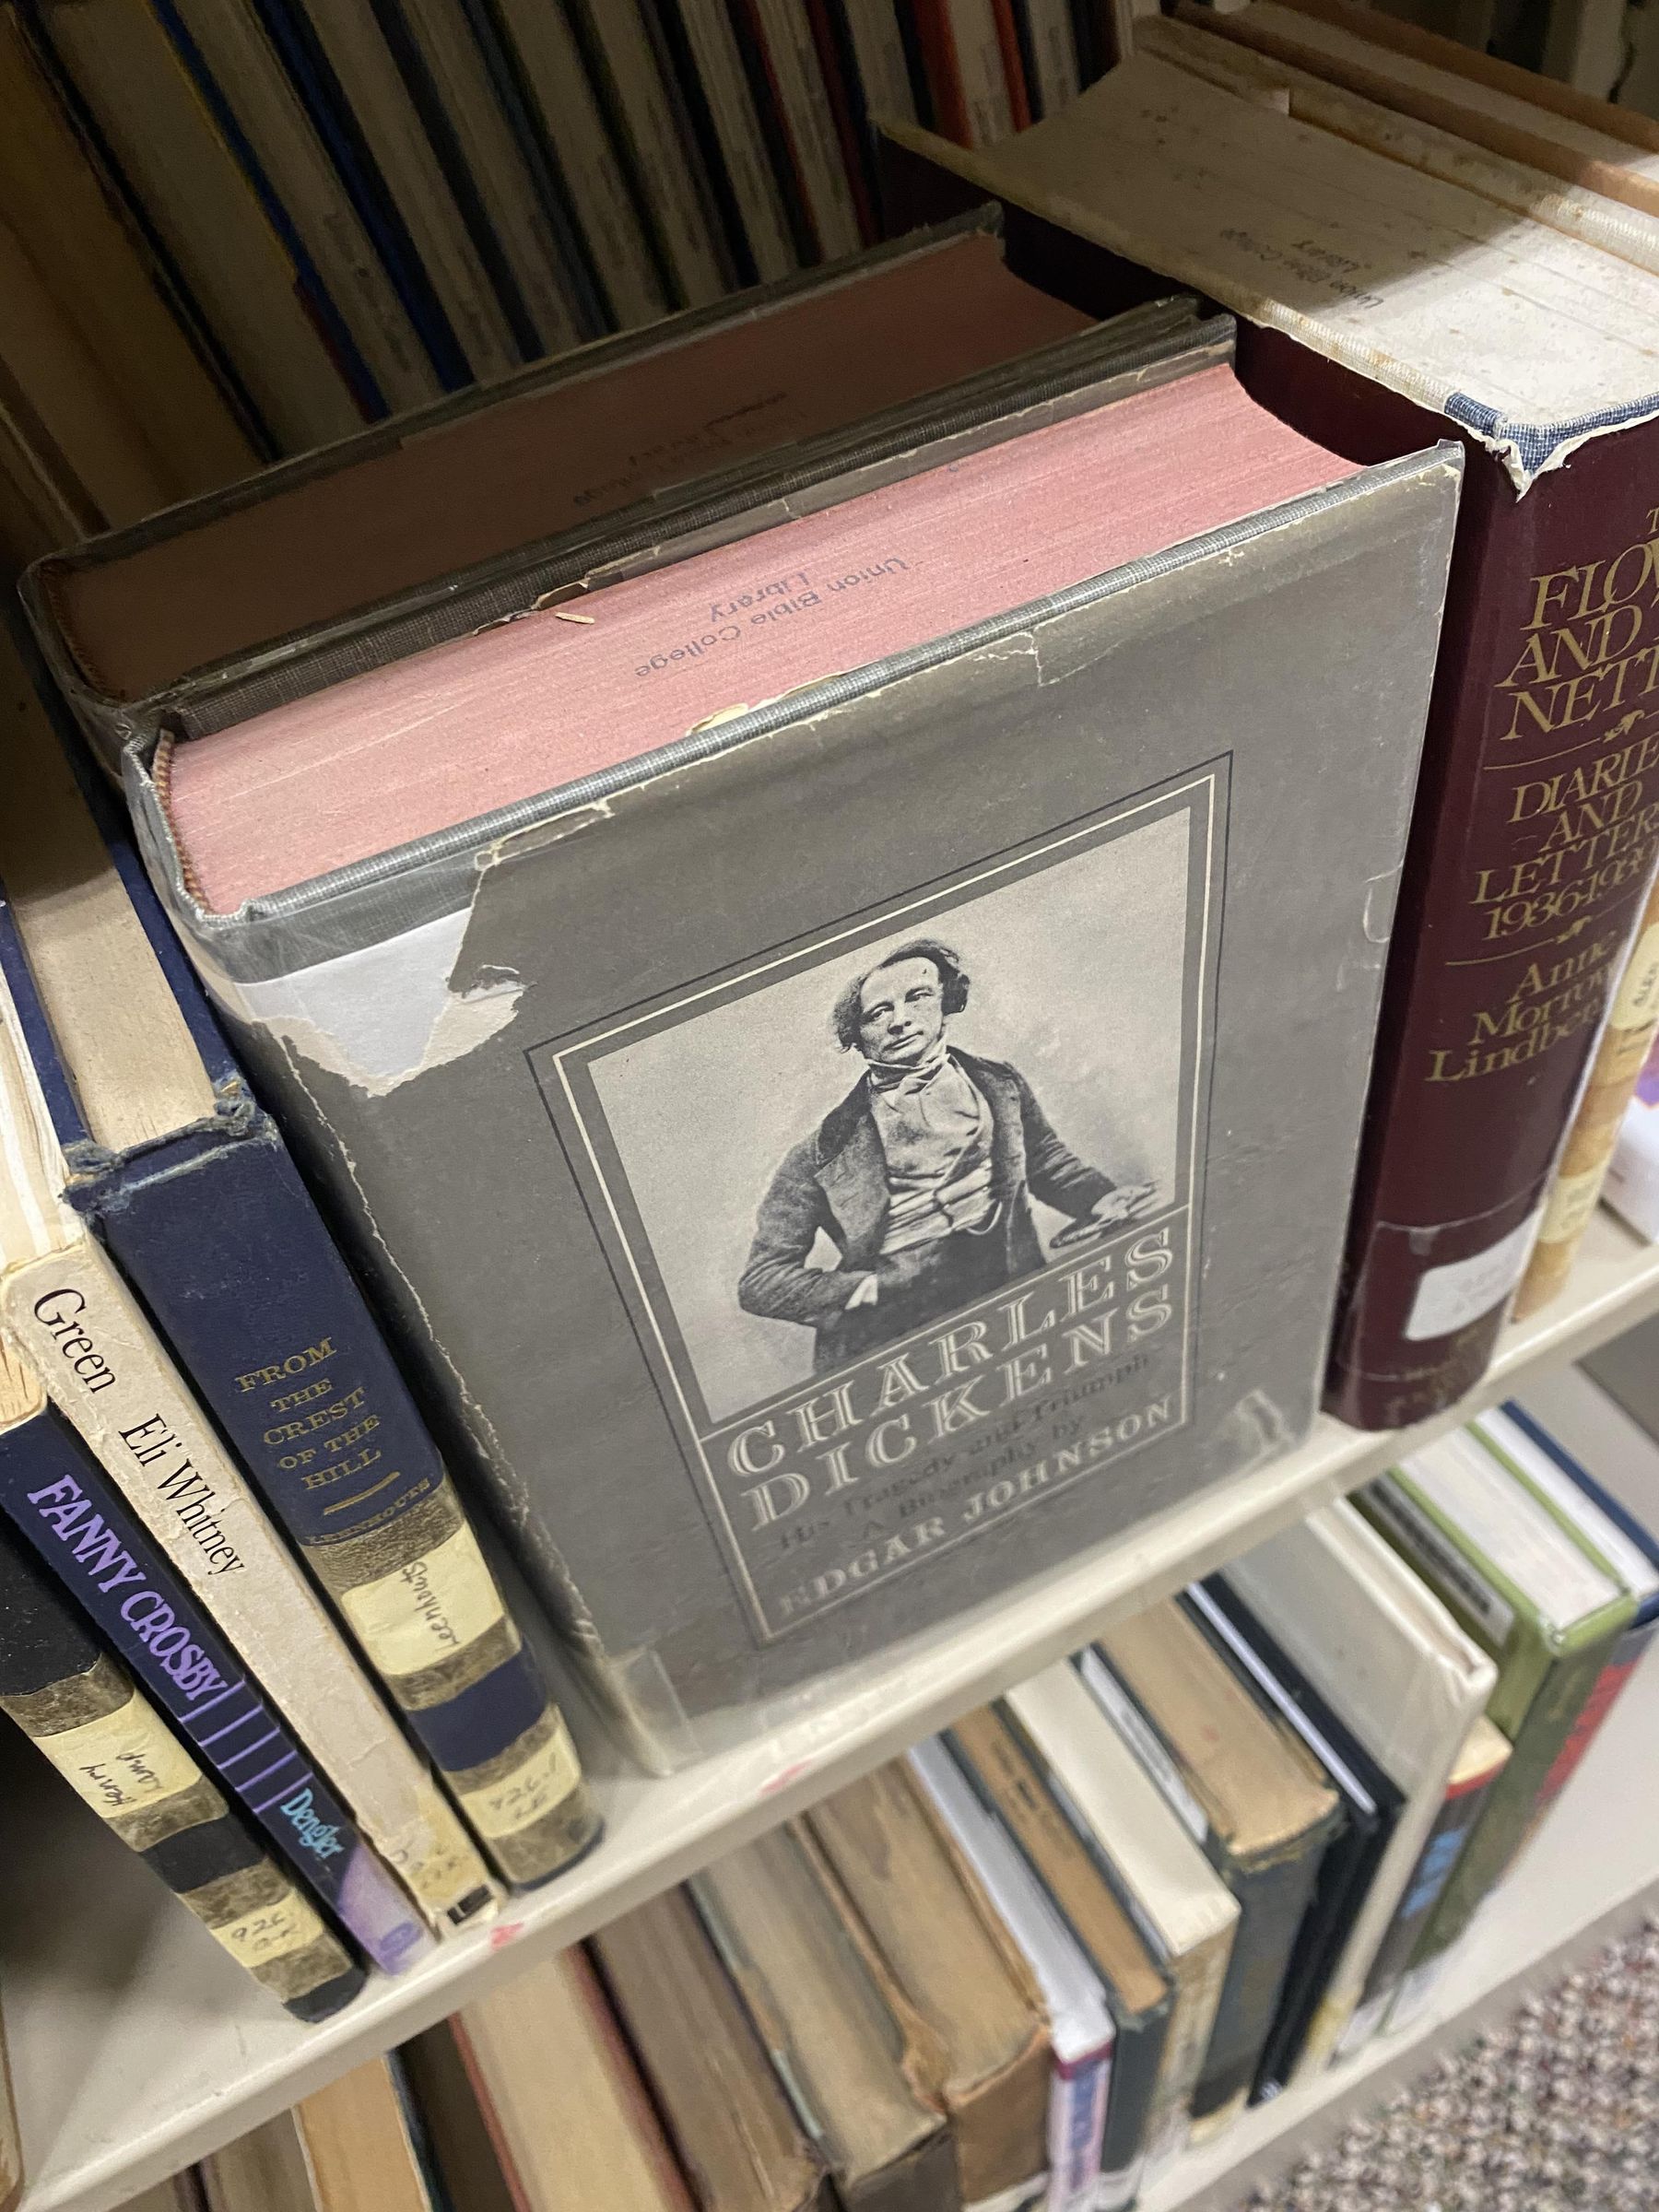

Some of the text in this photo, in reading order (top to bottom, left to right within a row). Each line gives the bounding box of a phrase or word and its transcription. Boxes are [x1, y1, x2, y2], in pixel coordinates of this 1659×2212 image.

[634, 556, 912, 679] Union Bible College
[709, 571, 811, 623] Library
[1519, 539, 1659, 630] FLO
[1494, 604, 1642, 688] AND
[1538, 780, 1642, 853] AND
[234, 1336, 337, 1393] FROM
[727, 1227, 1173, 1476] CHARLES
[33, 1288, 245, 1576] Green Eli Whitney
[263, 1386, 366, 1445] CREST
[269, 1377, 333, 1413] THE
[740, 1284, 1172, 1532] DICKENS
[278, 1414, 382, 1470] OF THE
[300, 1448, 382, 1490] HILL
[780, 1394, 1172, 1615] EDGAR JOHNSON
[27, 1474, 229, 1701] FANNY CROSBY
[280, 1787, 347, 1860] Dengler
